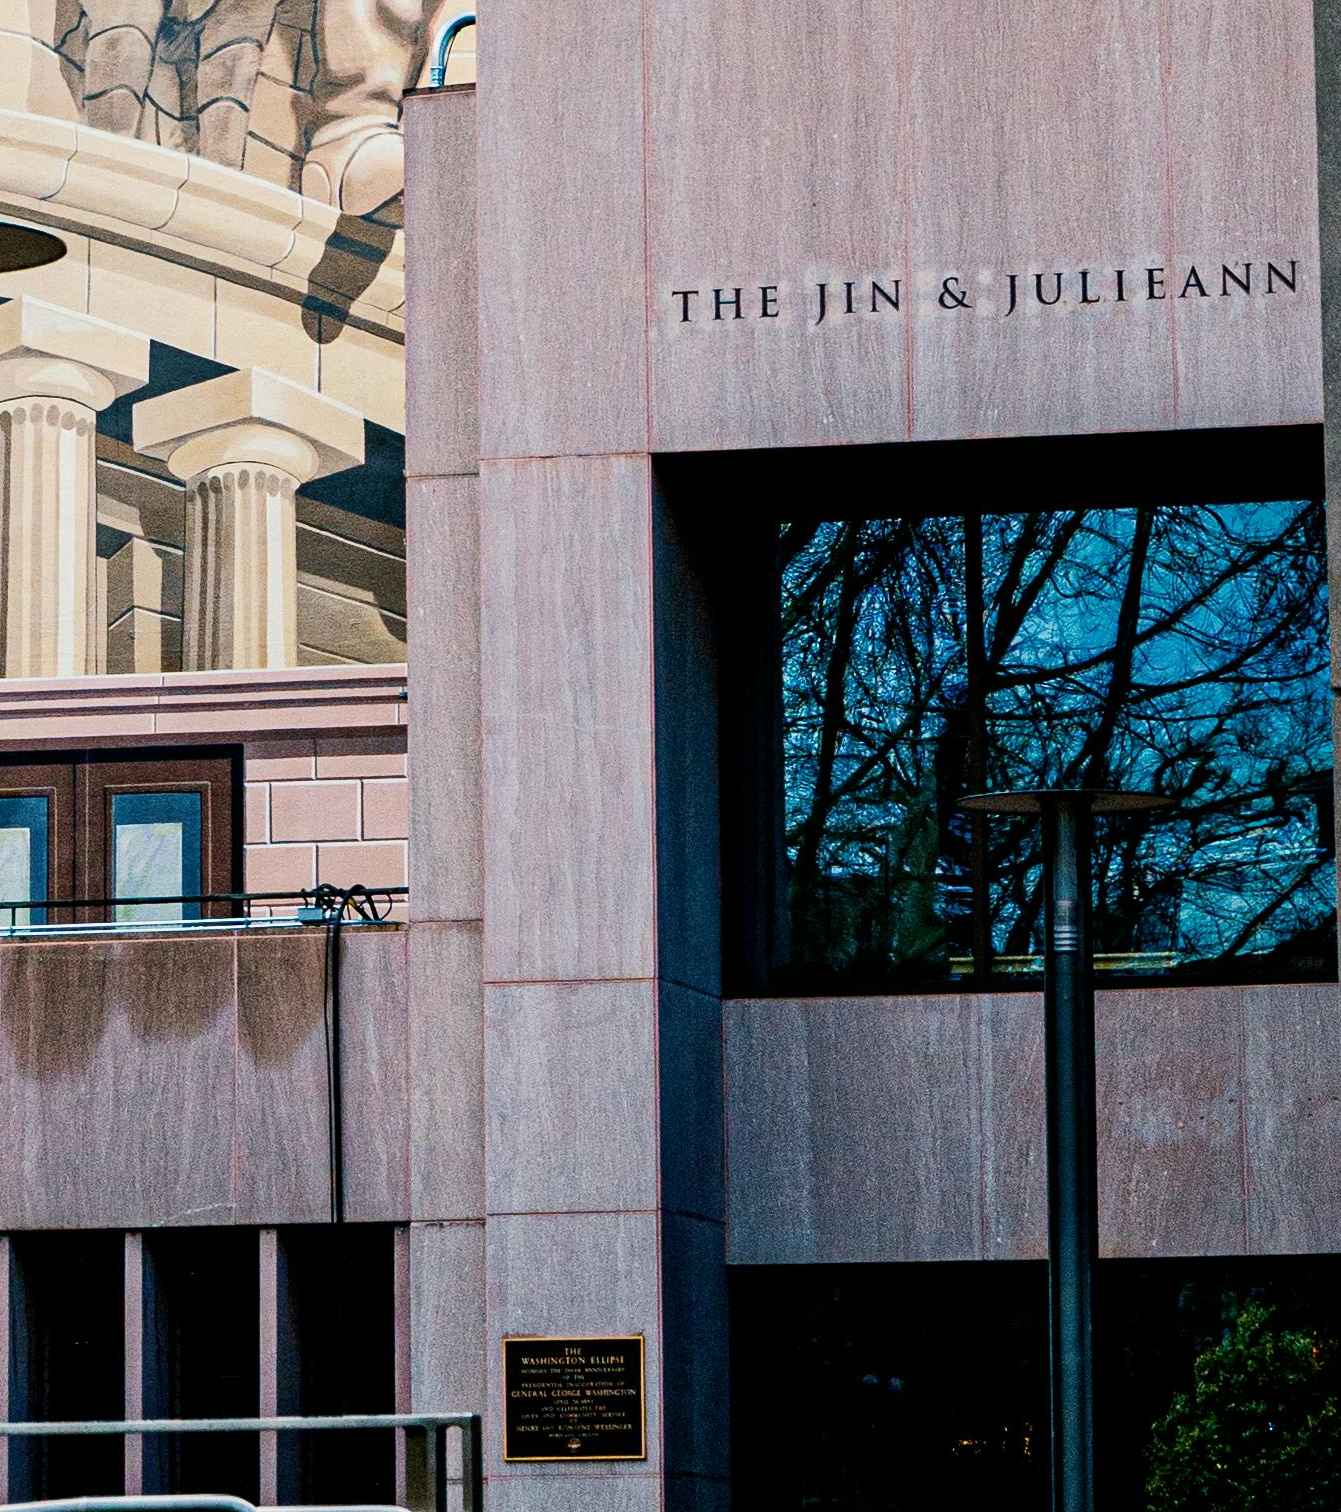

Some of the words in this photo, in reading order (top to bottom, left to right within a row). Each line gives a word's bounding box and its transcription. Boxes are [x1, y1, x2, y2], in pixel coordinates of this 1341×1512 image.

[672, 286, 780, 323] THE
[813, 279, 902, 326] JIN
[938, 277, 972, 310] &
[1005, 260, 1300, 317] JULIEANN
[564, 1347, 582, 1355] THE
[521, 1356, 586, 1365] WASHINGTON
[511, 1390, 547, 1398] GENERAL
[551, 1389, 581, 1397] GEORGE
[585, 1388, 636, 1397] WASHINGTON
